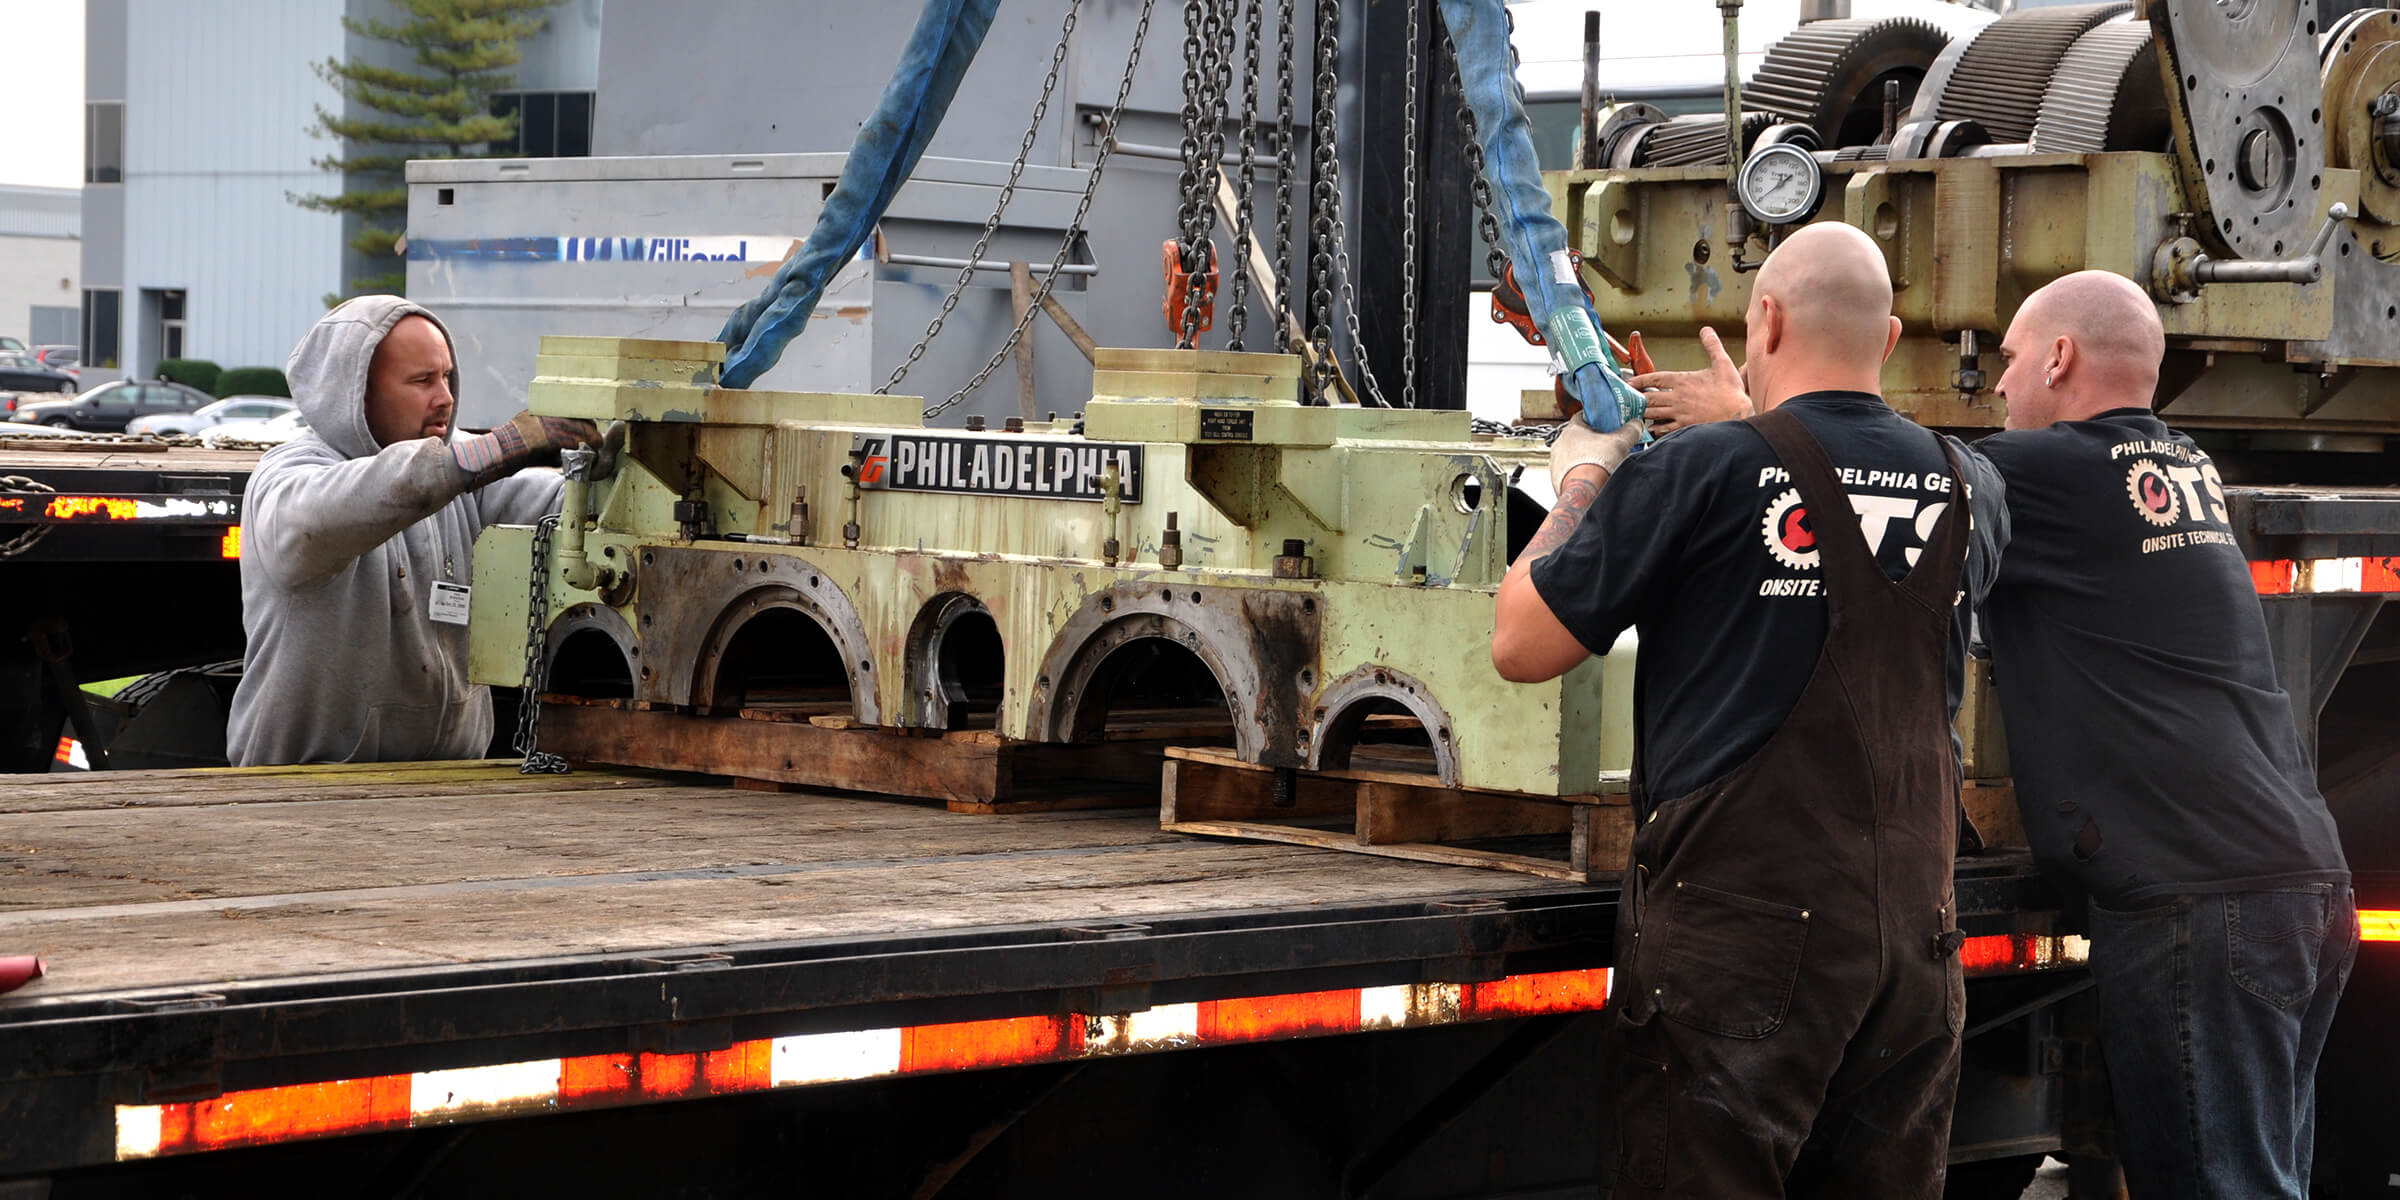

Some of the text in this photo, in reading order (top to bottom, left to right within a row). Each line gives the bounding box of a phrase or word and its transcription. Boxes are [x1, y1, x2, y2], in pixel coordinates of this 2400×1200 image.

[896, 441, 1134, 496] PHILADELPHIA
[1923, 472, 1973, 499] GER
[2142, 533, 2186, 554] ONSITE
[1759, 578, 1821, 597] ONSITE
